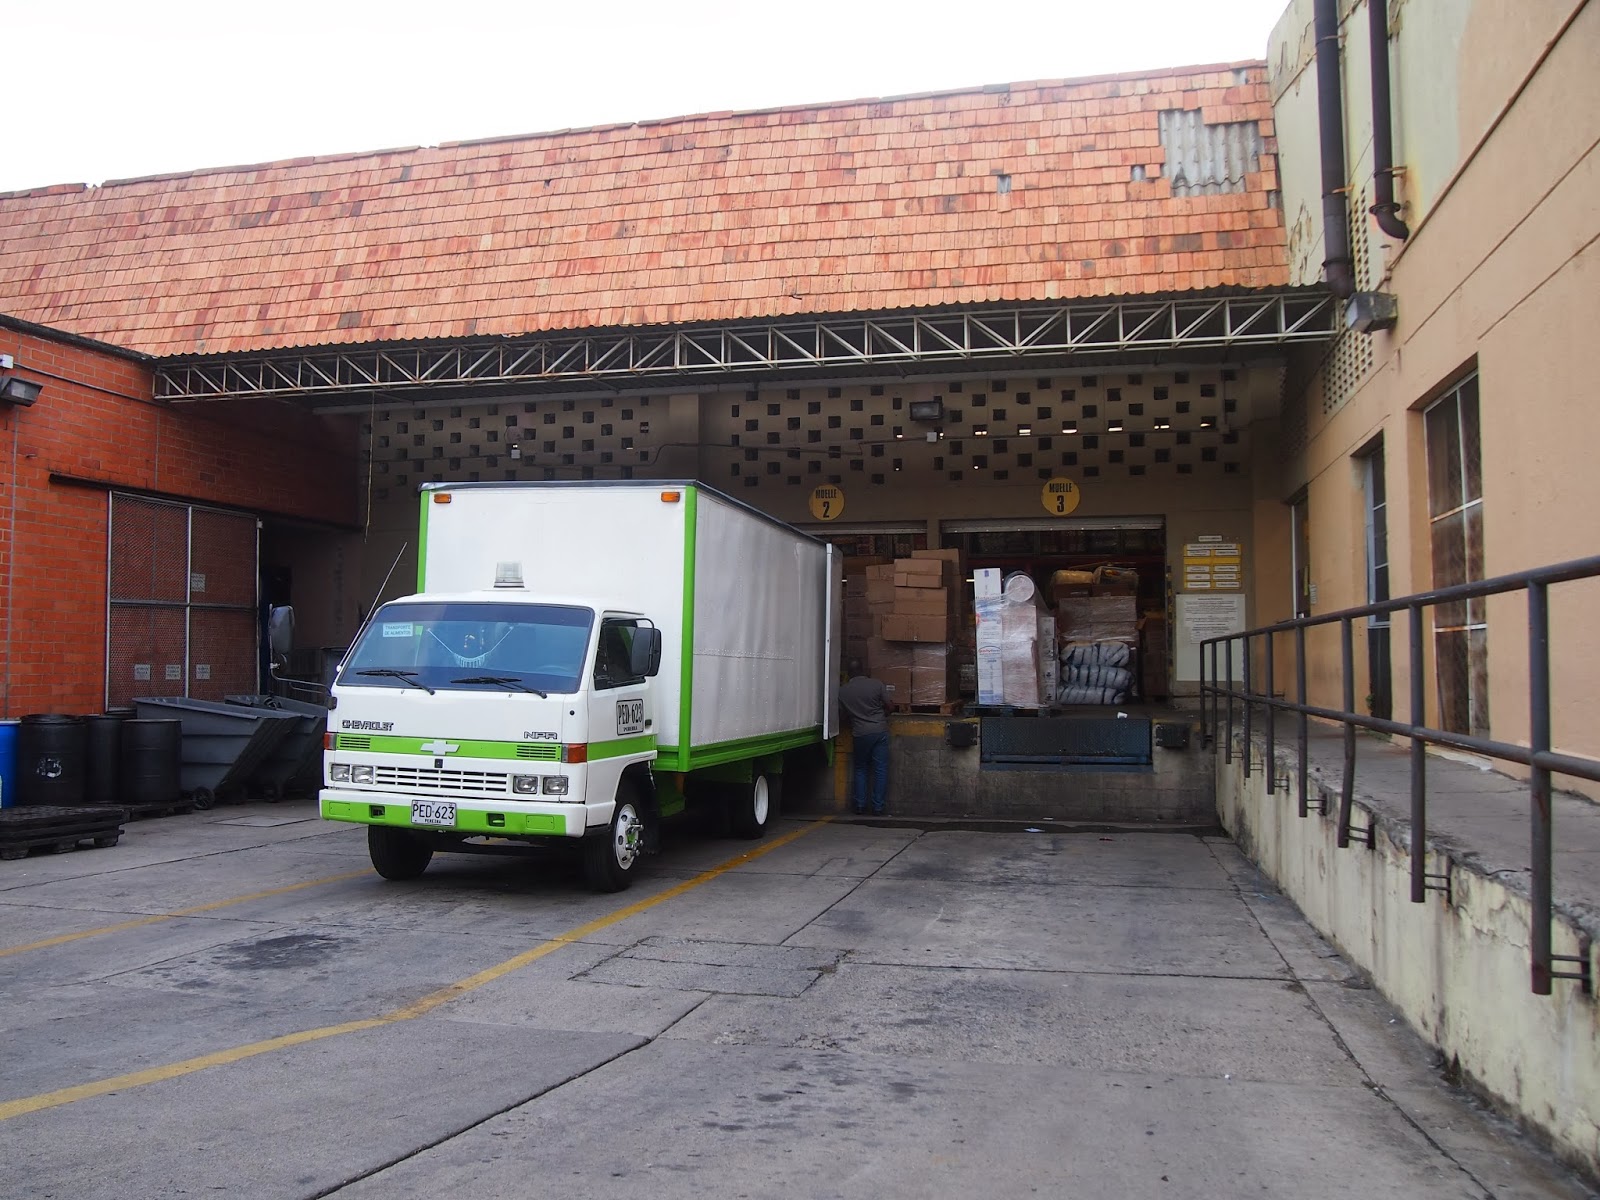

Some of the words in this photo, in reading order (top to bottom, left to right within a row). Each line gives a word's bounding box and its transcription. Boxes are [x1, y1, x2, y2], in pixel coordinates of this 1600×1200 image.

[1049, 482, 1072, 493] MUELLE
[815, 489, 837, 499] MUELLE
[822, 501, 830, 518] 2
[1056, 495, 1065, 513] 3
[342, 719, 394, 732] CHEVROLET
[523, 731, 558, 740] NPR
